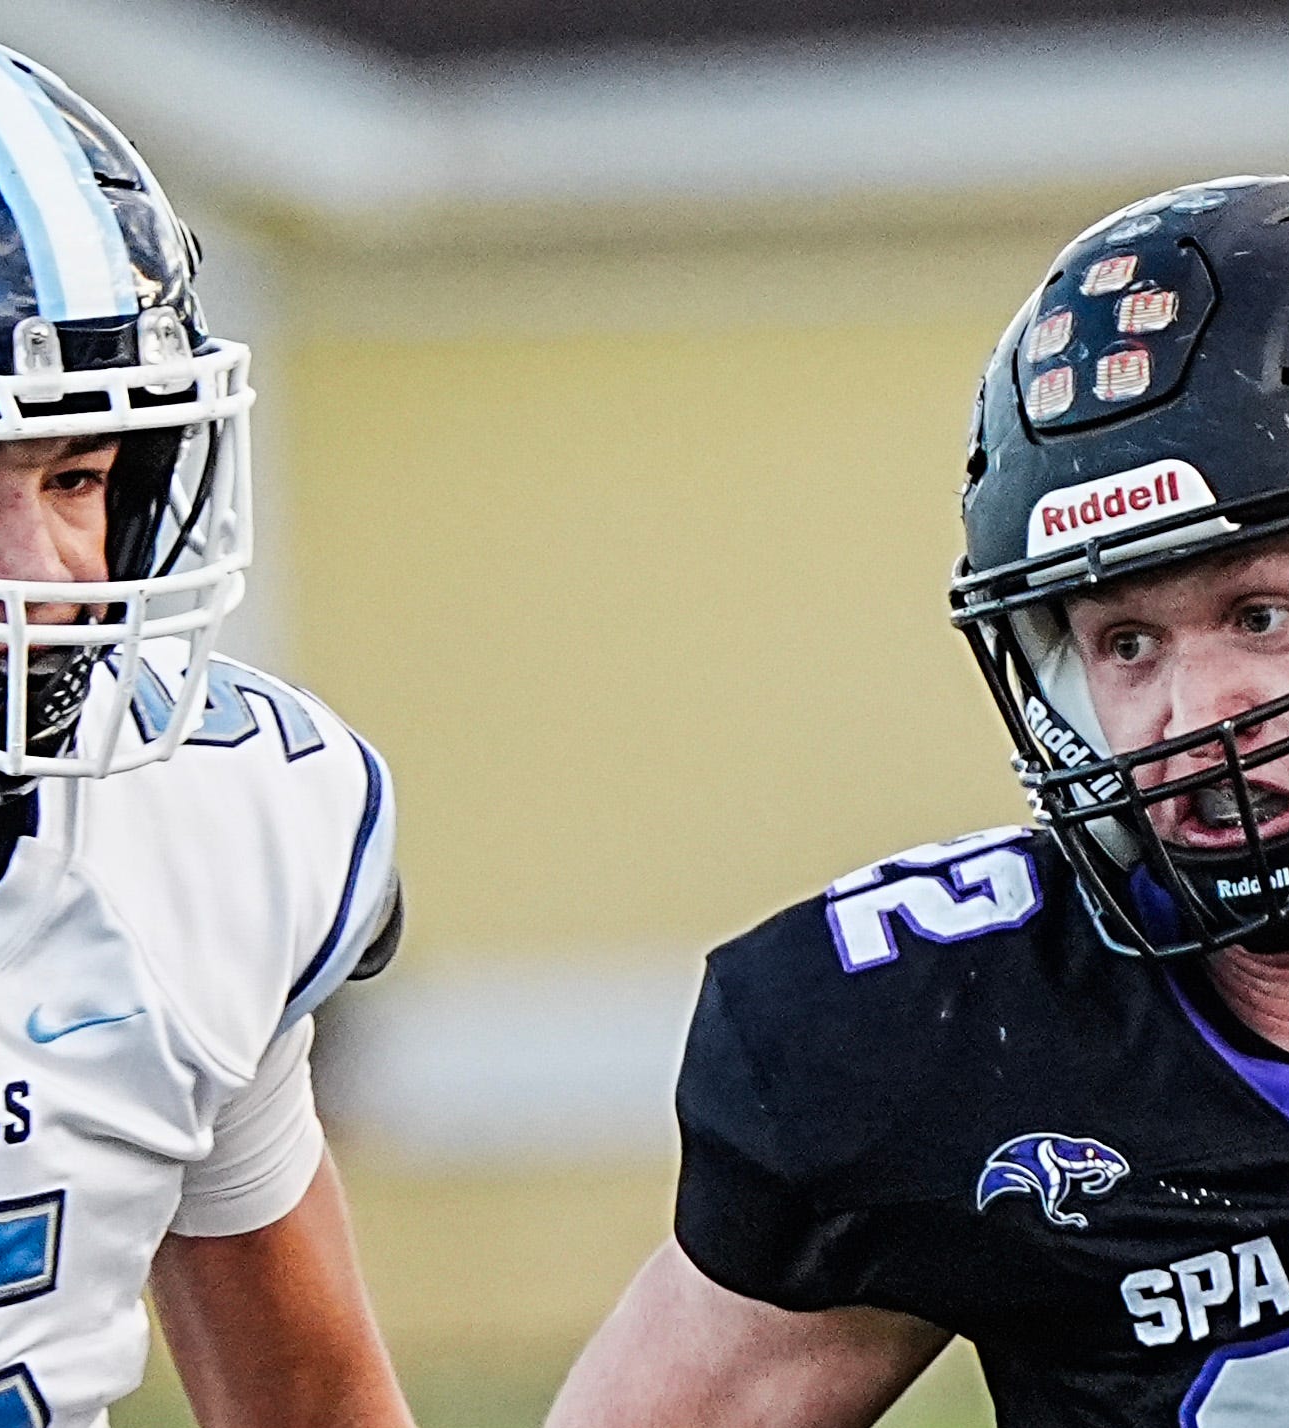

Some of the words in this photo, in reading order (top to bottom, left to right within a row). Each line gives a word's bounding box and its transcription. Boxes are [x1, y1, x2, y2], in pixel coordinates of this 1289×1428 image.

[1042, 471, 1179, 536] Riddell
[104, 652, 326, 764] 5
[1025, 696, 1122, 800] Riddll
